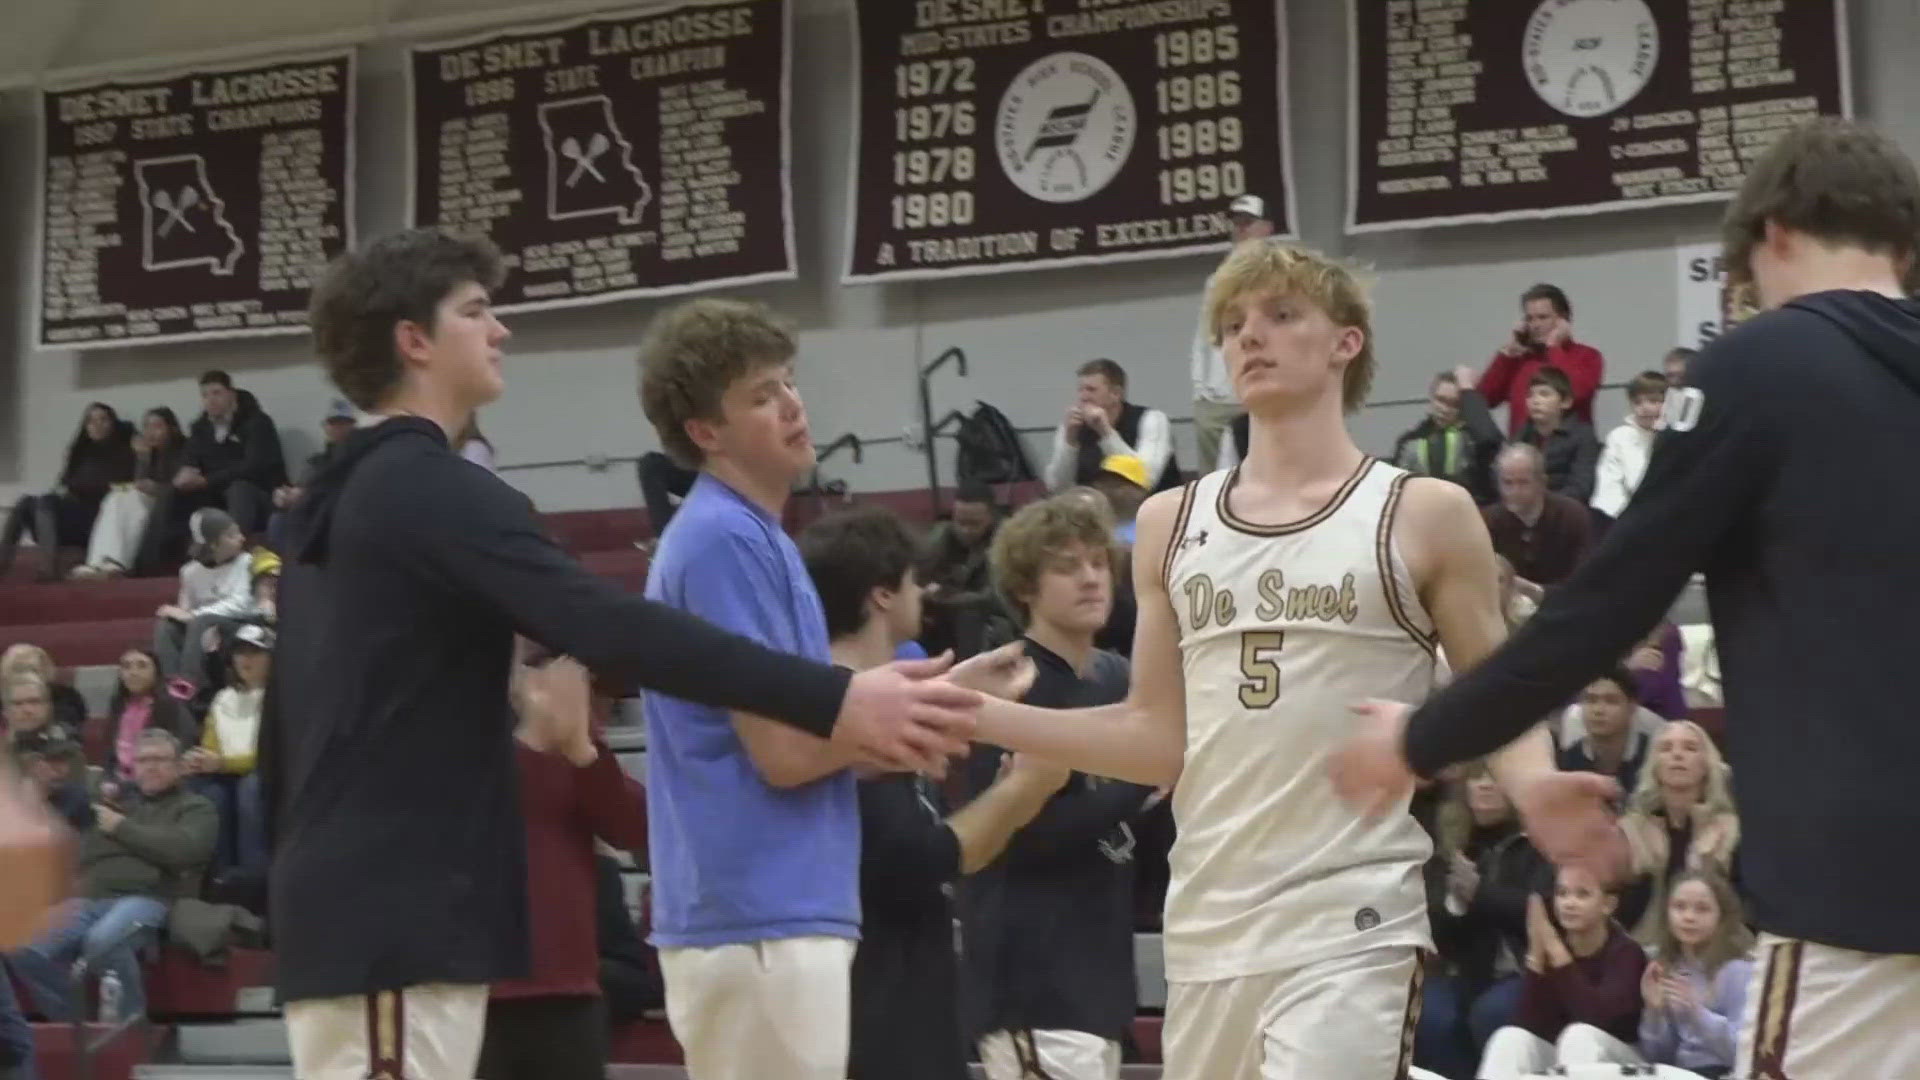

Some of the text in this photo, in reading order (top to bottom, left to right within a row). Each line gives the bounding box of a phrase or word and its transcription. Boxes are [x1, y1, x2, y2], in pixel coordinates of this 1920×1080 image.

[439, 7, 754, 82] DESMET LACROSSE
[1154, 25, 1240, 68] 1985
[192, 64, 338, 107] LACROSSE
[544, 64, 600, 94] STATE
[629, 45, 726, 81] CHAMPION
[895, 57, 976, 98] 1972
[1156, 70, 1242, 114] 1986
[130, 112, 195, 140] STATE
[895, 101, 976, 141] 1976
[1157, 116, 1242, 160] 1989
[893, 145, 976, 185] 1978
[1158, 160, 1245, 205] 1990
[891, 190, 975, 229] 1980
[876, 241, 896, 267] A
[907, 230, 1038, 263] TRADITION
[1050, 225, 1084, 251] OF
[1183, 567, 1359, 631] De Smet
[1237, 630, 1285, 710] 5
